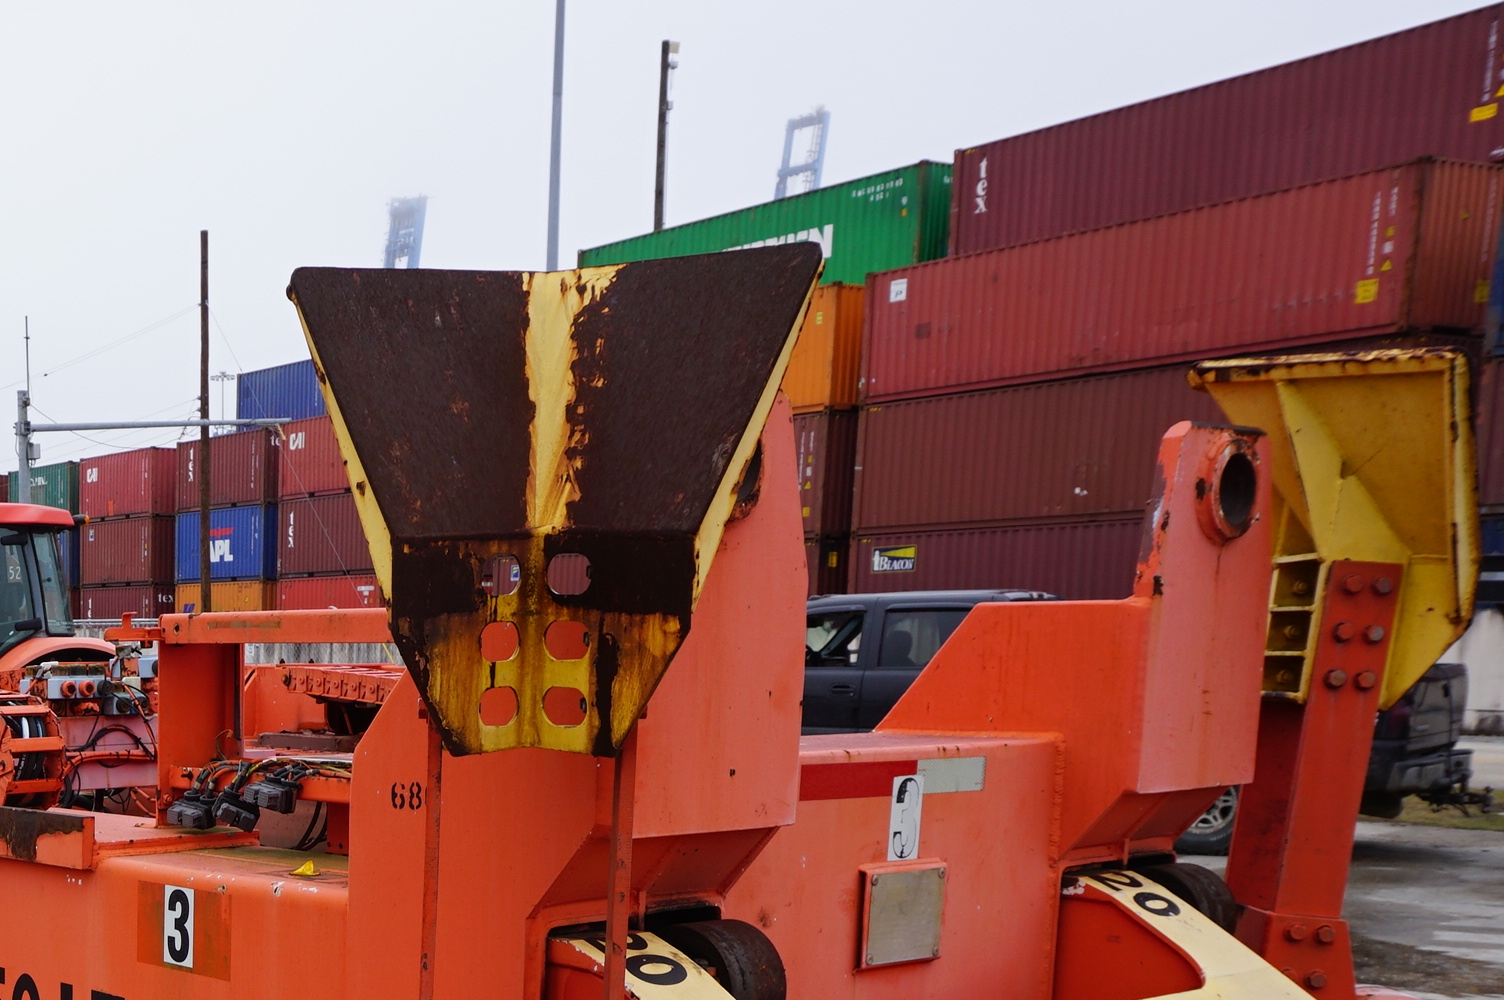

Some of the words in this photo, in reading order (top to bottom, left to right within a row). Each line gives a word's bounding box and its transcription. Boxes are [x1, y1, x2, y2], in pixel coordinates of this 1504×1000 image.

[974, 157, 988, 214] tex
[879, 556, 915, 571] BEACON
[391, 781, 427, 810] 68
[167, 889, 190, 963] 3
